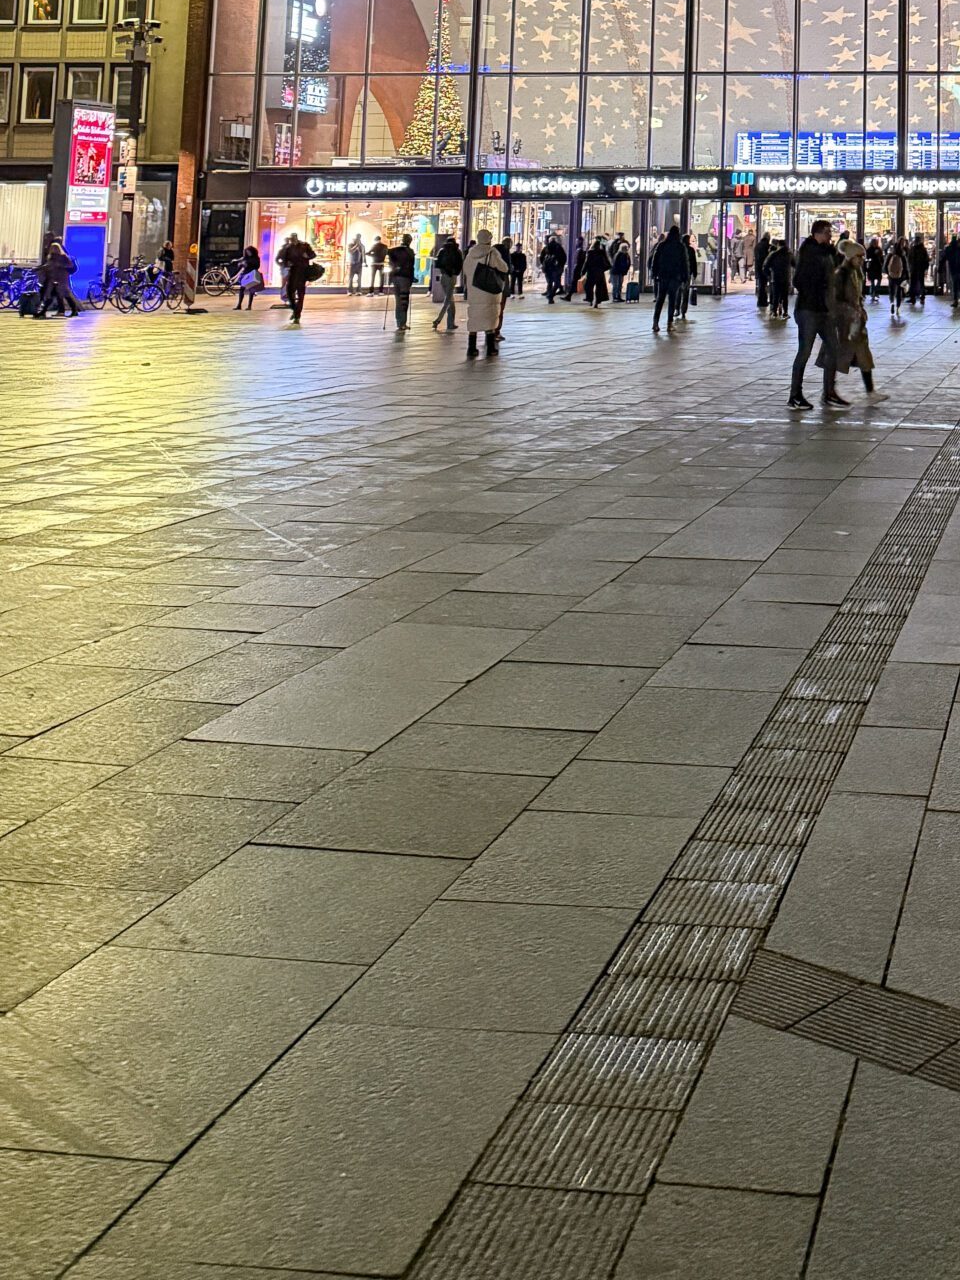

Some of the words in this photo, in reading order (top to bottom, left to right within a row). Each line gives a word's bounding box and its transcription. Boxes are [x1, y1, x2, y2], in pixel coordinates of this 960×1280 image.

[325, 181, 347, 192] THE
[347, 181, 377, 192] BODY
[376, 181, 408, 192] SHOP
[510, 177, 600, 195] NetCologne
[640, 177, 719, 195] Highspeed
[758, 177, 847, 195] NetCologne
